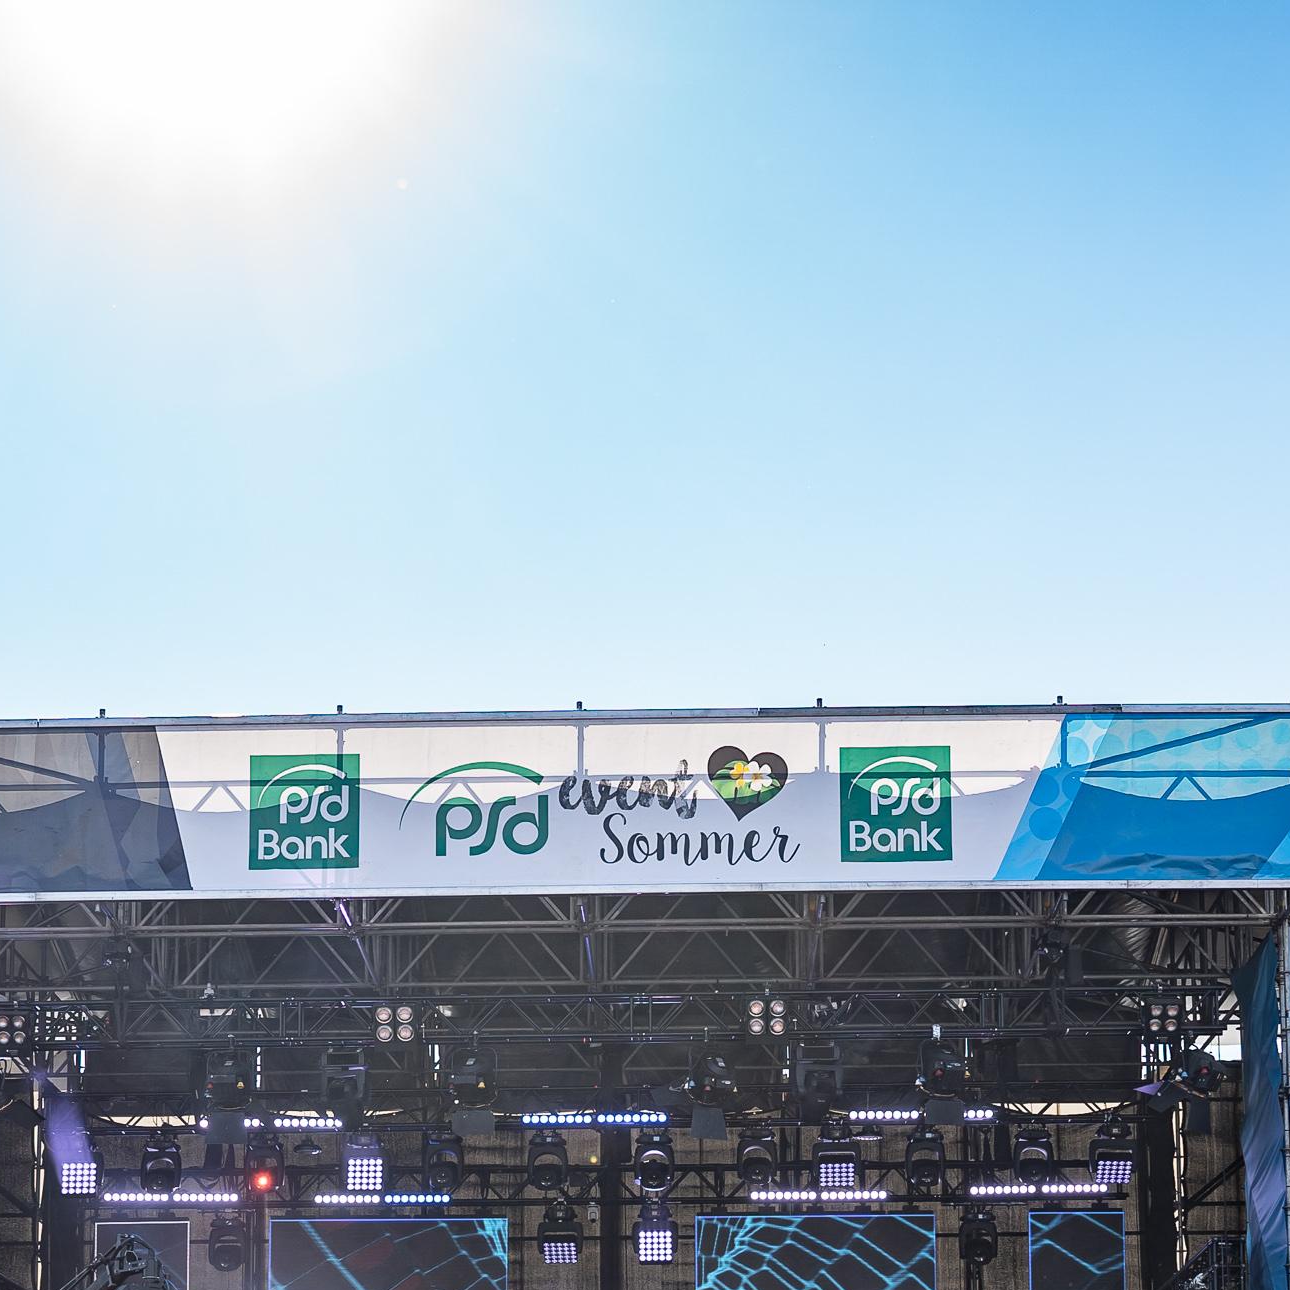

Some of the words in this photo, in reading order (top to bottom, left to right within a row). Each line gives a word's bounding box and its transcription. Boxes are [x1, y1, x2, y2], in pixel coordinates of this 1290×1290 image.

[279, 785, 350, 824] psd
[558, 758, 699, 820] event
[870, 777, 941, 816] psd
[257, 827, 351, 860] Bank
[435, 795, 549, 857] psd
[599, 812, 801, 867] Sommer
[848, 820, 944, 853] Bank
